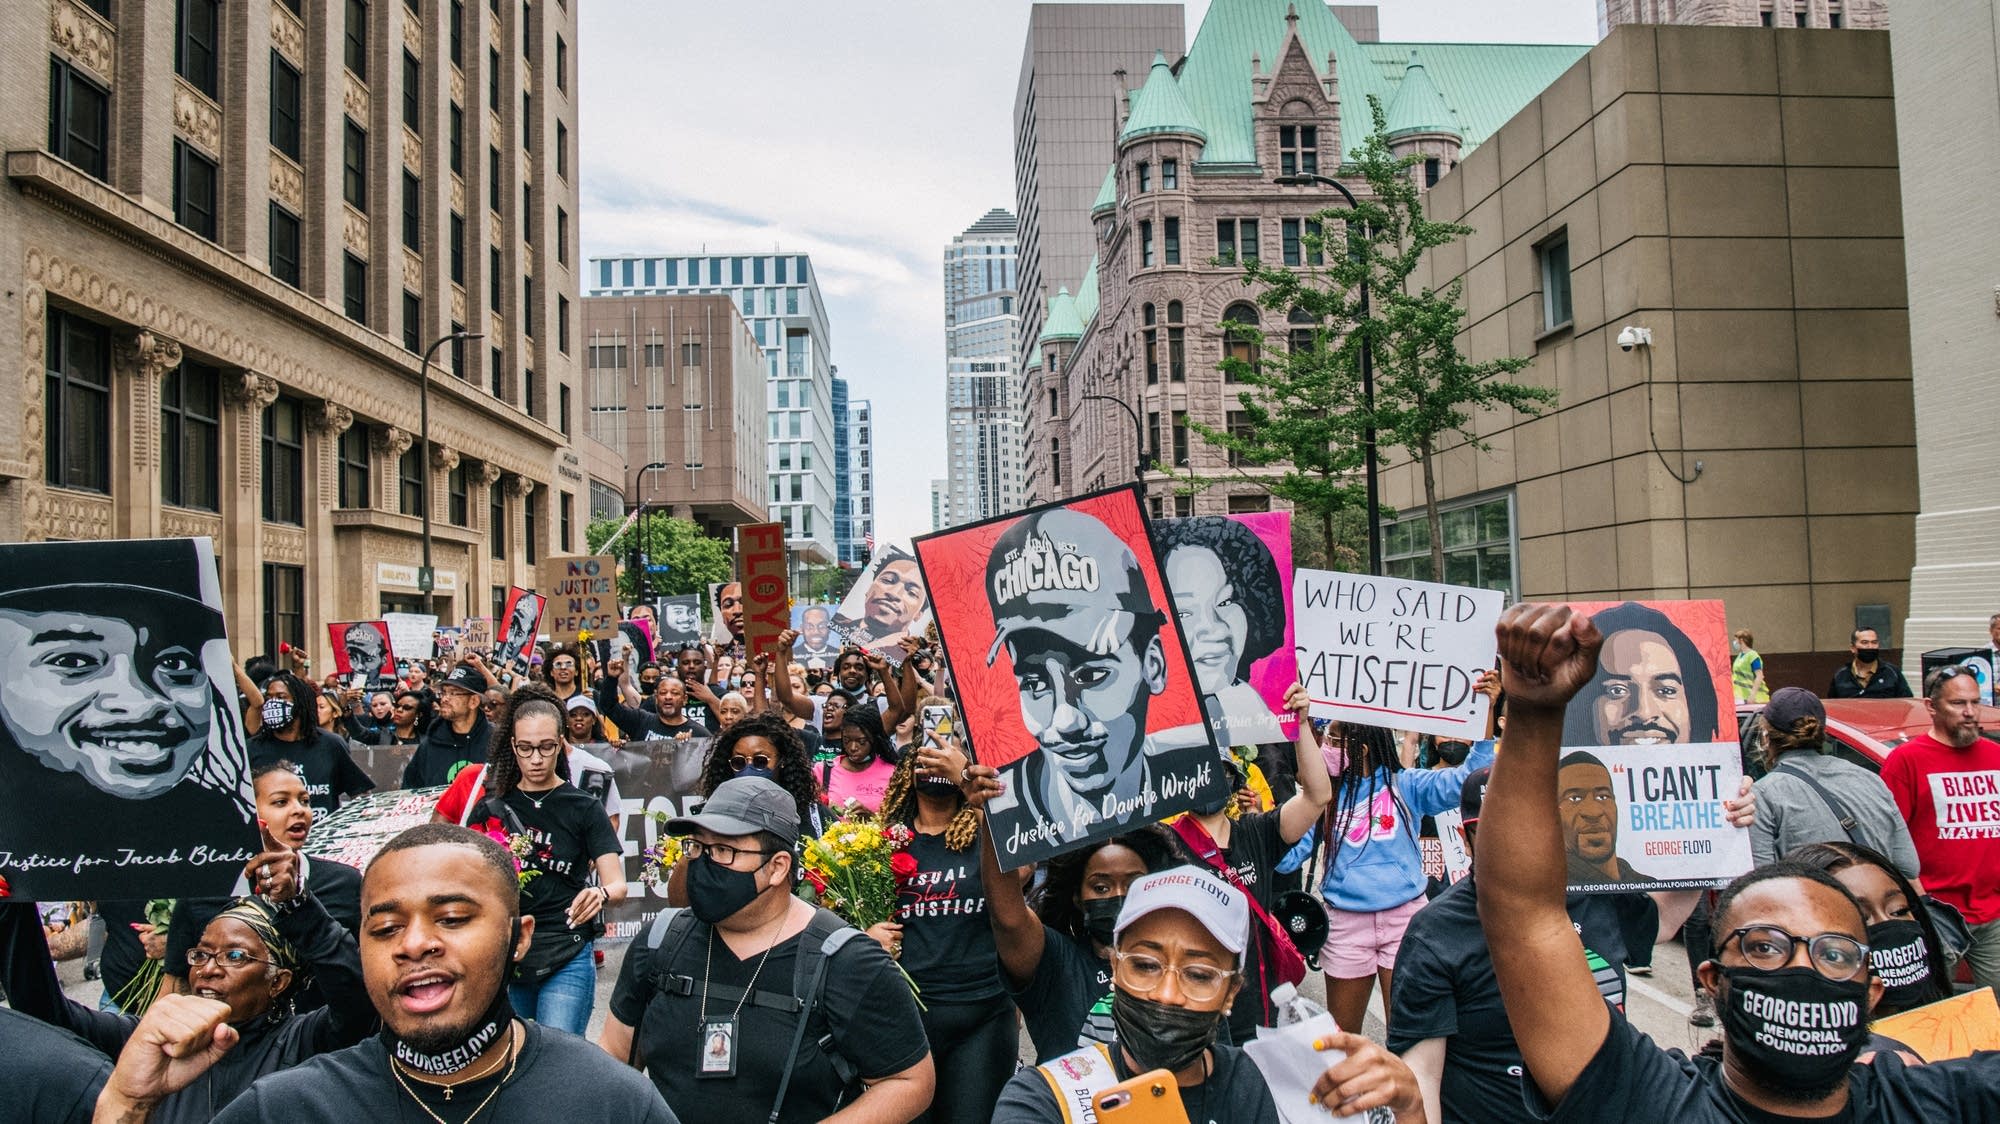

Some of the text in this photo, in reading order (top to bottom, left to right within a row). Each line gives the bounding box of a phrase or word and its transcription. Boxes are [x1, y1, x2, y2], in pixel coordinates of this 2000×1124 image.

[567, 560, 600, 577] NO
[994, 551, 1099, 605] CHICAGO
[553, 577, 610, 596] JUSTICE
[568, 597, 600, 613] NO
[1305, 580, 1477, 623] WHO SAID
[470, 622, 484, 631] HIS
[554, 614, 611, 632] PEACE
[1340, 621, 1436, 652] WE'RE
[1642, 765, 1721, 801] CAN'T
[1942, 775, 1999, 797] BLACK
[1006, 761, 1211, 854] Justice for Daunte Wright
[1947, 800, 2000, 823] LIVES
[1937, 826, 2000, 840] MATTE
[0, 845, 255, 874] Justice for Jacob Blake
[908, 866, 967, 886] ISUAL
[901, 898, 985, 919] JUSTICE
[1878, 960, 1925, 978] MEMORIAL
[1882, 966, 1930, 988] OUNDATION
[1743, 990, 1858, 1029] GEORGEFLOYD
[1763, 1022, 1843, 1043] MEMORIAL
[1755, 1032, 1848, 1056] FOUNDATION
[1075, 1088, 1099, 1124] BLAC
